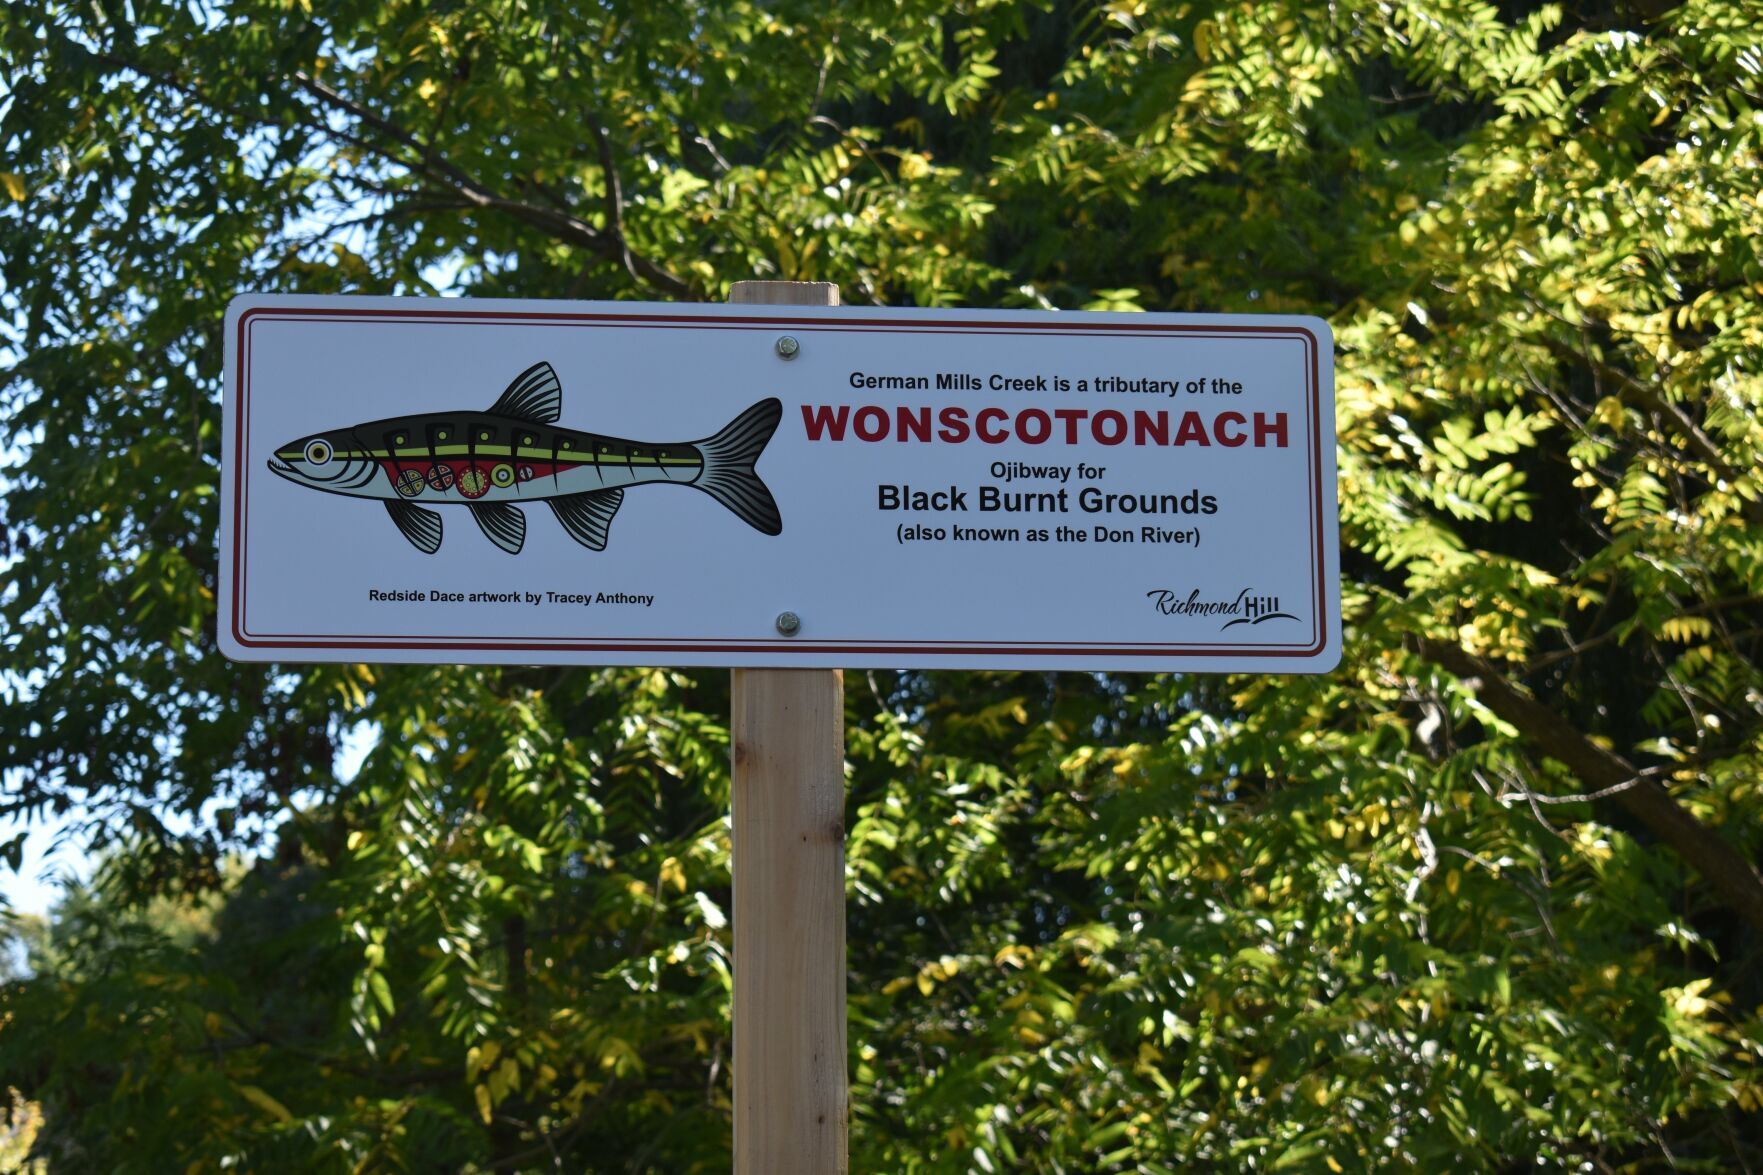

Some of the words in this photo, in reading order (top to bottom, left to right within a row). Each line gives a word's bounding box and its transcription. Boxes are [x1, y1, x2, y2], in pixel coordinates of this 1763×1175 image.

[850, 372, 928, 389] German
[936, 374, 982, 390] Mills
[989, 374, 1047, 391] Creek
[1054, 376, 1070, 392] is
[1077, 380, 1088, 392] a
[1094, 377, 1179, 397] tributary
[1186, 378, 1206, 393] of
[1211, 378, 1242, 394] the
[801, 405, 1288, 448] WONSCOTONACH
[991, 462, 1071, 483] Ojibway
[1077, 463, 1106, 479] for
[879, 485, 968, 511] Black
[979, 486, 1068, 512] Burnt
[1079, 487, 1218, 514] Grounds
[897, 524, 946, 544] (also
[953, 525, 1019, 541] known
[1026, 529, 1049, 542] as
[1056, 526, 1087, 542] the
[1095, 526, 1133, 542] Don
[1142, 527, 1200, 547] River)
[369, 590, 425, 601] Redside
[430, 590, 464, 602] Dace
[469, 592, 521, 602] artwork
[526, 592, 542, 605] by
[546, 592, 592, 606] Tracey
[595, 592, 654, 607] Anthony
[1146, 587, 1254, 616] Richmond
[1245, 597, 1279, 618] Hill
